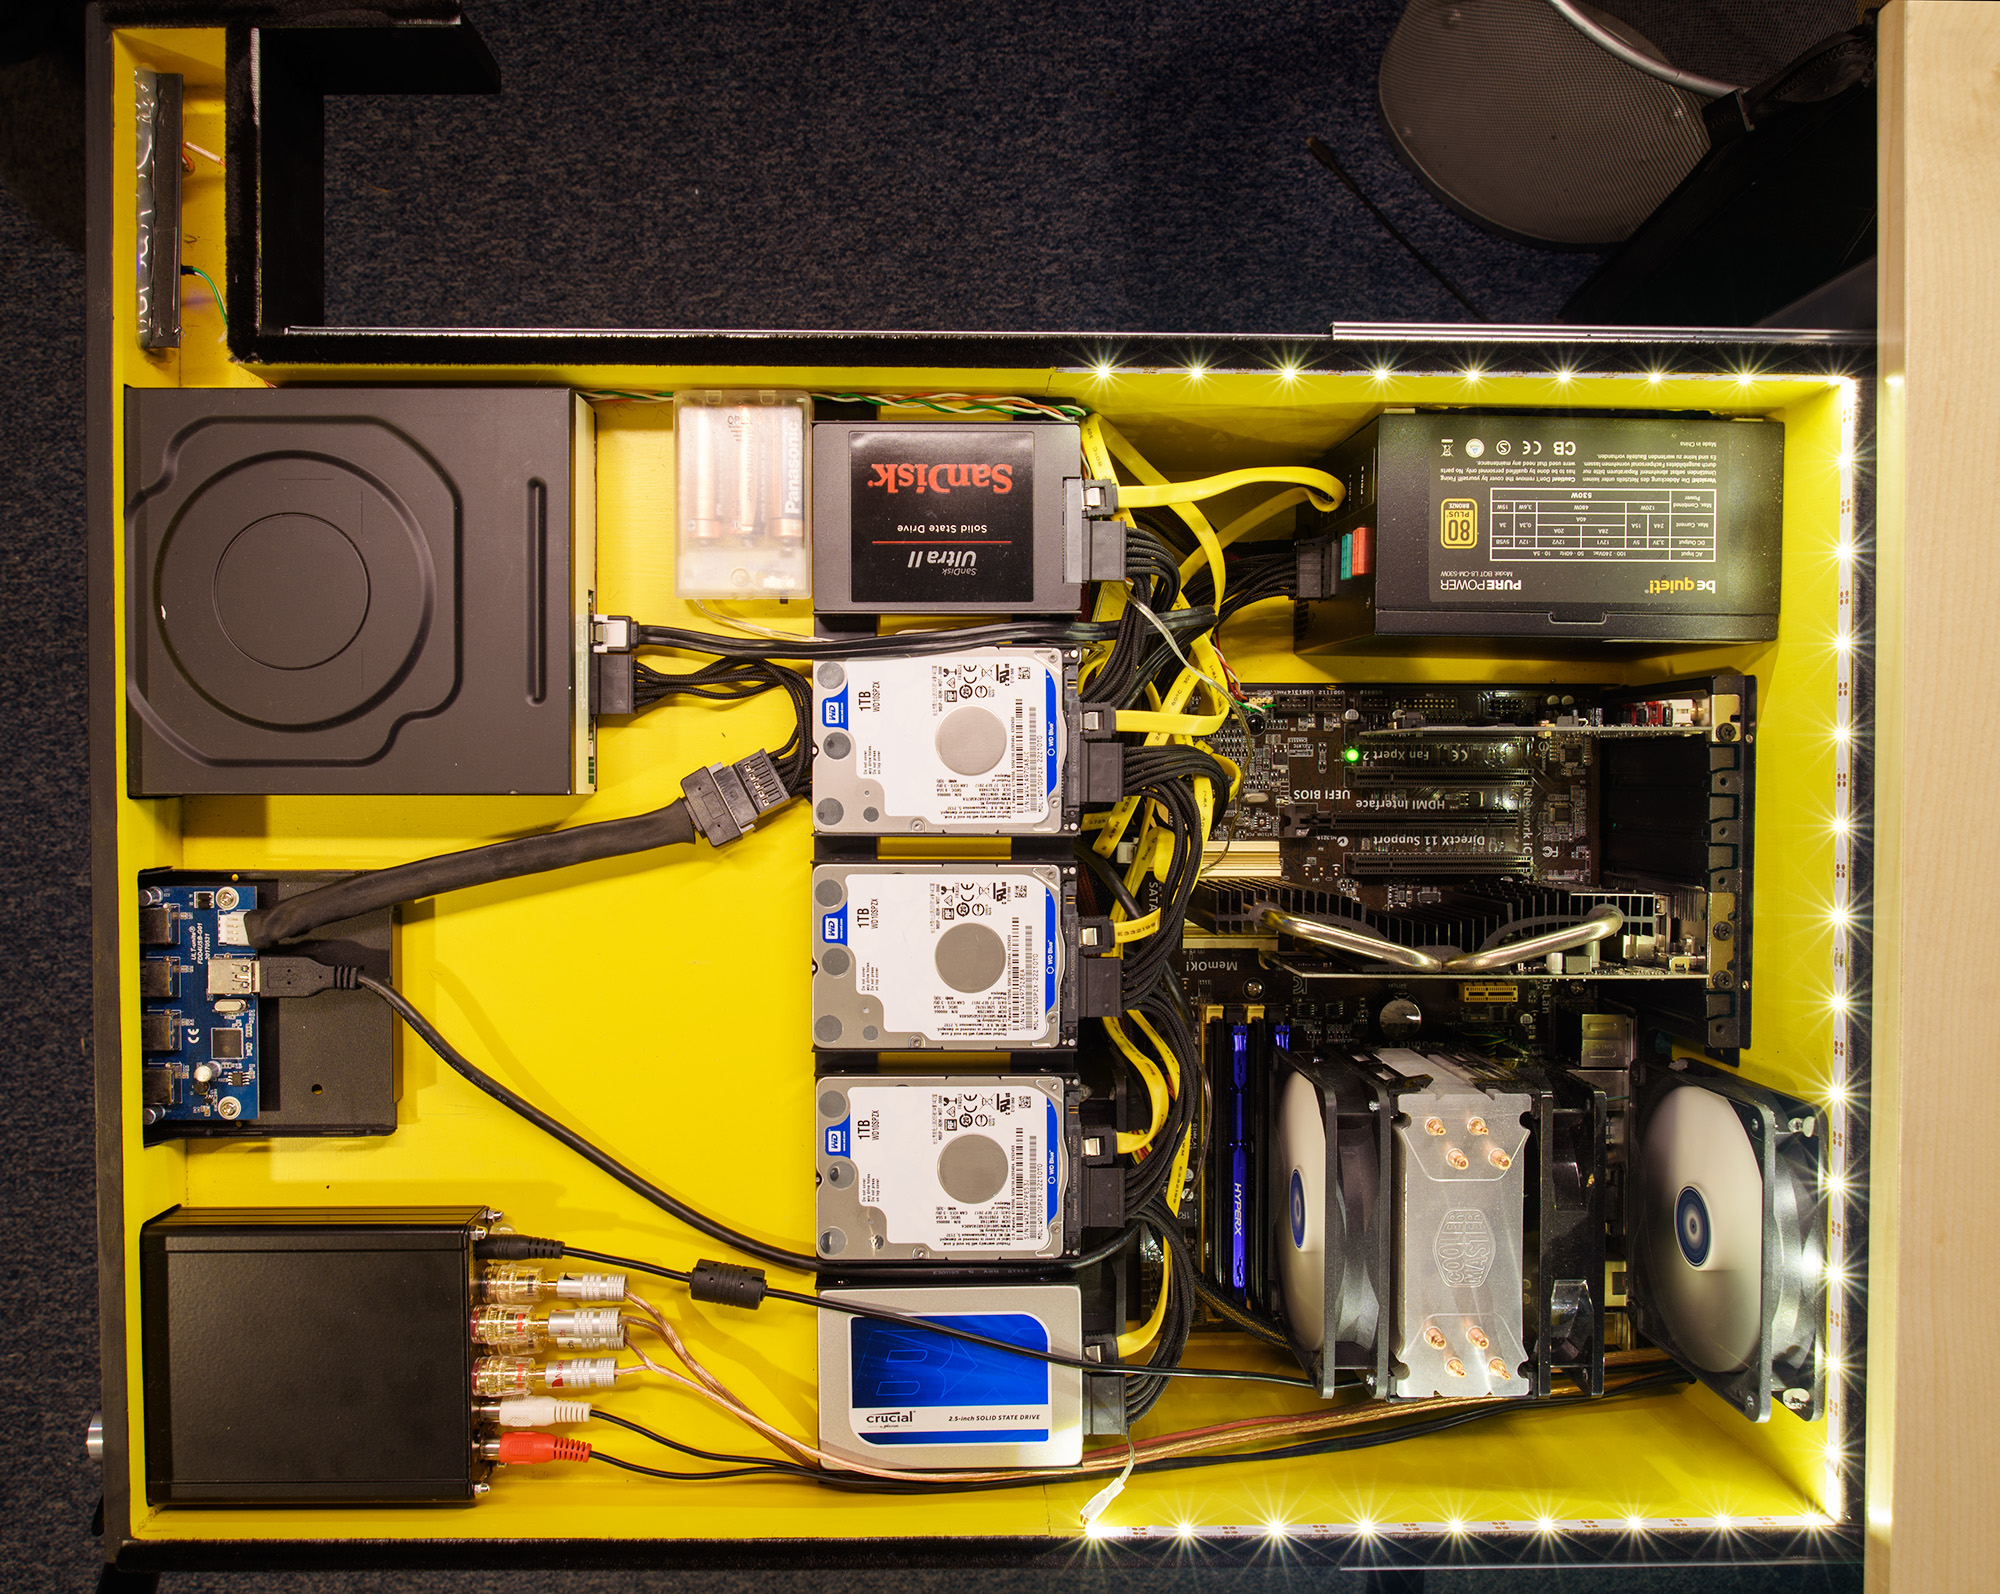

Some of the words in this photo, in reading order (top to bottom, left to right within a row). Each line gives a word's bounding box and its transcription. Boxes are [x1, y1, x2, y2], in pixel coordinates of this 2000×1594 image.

[1522, 440, 1542, 455] CE
[1553, 441, 1576, 455] CB
[785, 420, 799, 515] Panasonic
[871, 463, 1012, 494] SanDisk
[1570, 491, 1592, 499] 530W
[897, 524, 925, 534] Drive
[929, 524, 956, 534] State
[960, 524, 987, 534] Solid
[1448, 519, 1471, 541] 80
[907, 550, 923, 568] II
[926, 550, 977, 567] Ultra
[942, 568, 977, 576] SanDisk
[1649, 577, 1695, 594] quiet!
[1696, 580, 1716, 594] be
[858, 691, 871, 712] 1TB
[828, 705, 836, 721] WD
[1048, 736, 1054, 747] WD
[1362, 751, 1369, 760] 2
[1373, 748, 1405, 760] Xpert
[1409, 750, 1429, 760] Fan
[1452, 749, 1468, 762] CE
[1293, 789, 1321, 800] BIOS
[1324, 789, 1351, 800] UEFI
[1355, 799, 1409, 810] Interface
[1412, 799, 1445, 809] HDMI
[1109, 820, 1121, 840] AWM
[1373, 833, 1421, 846] Support
[1425, 836, 1438, 845] 11
[1441, 835, 1485, 846] DirectX
[857, 908, 869, 928] 1TB
[828, 920, 835, 937] WD
[1047, 955, 1053, 965] WD
[1186, 960, 1238, 971] MemOK!
[1542, 994, 1551, 1014] Lan
[187, 1028, 200, 1044] CE
[858, 1120, 870, 1140] 1TB
[831, 1133, 838, 1149] WD
[1049, 1165, 1054, 1175] WD
[1233, 1182, 1242, 1237] HYPERX
[866, 1411, 913, 1423] crucial
